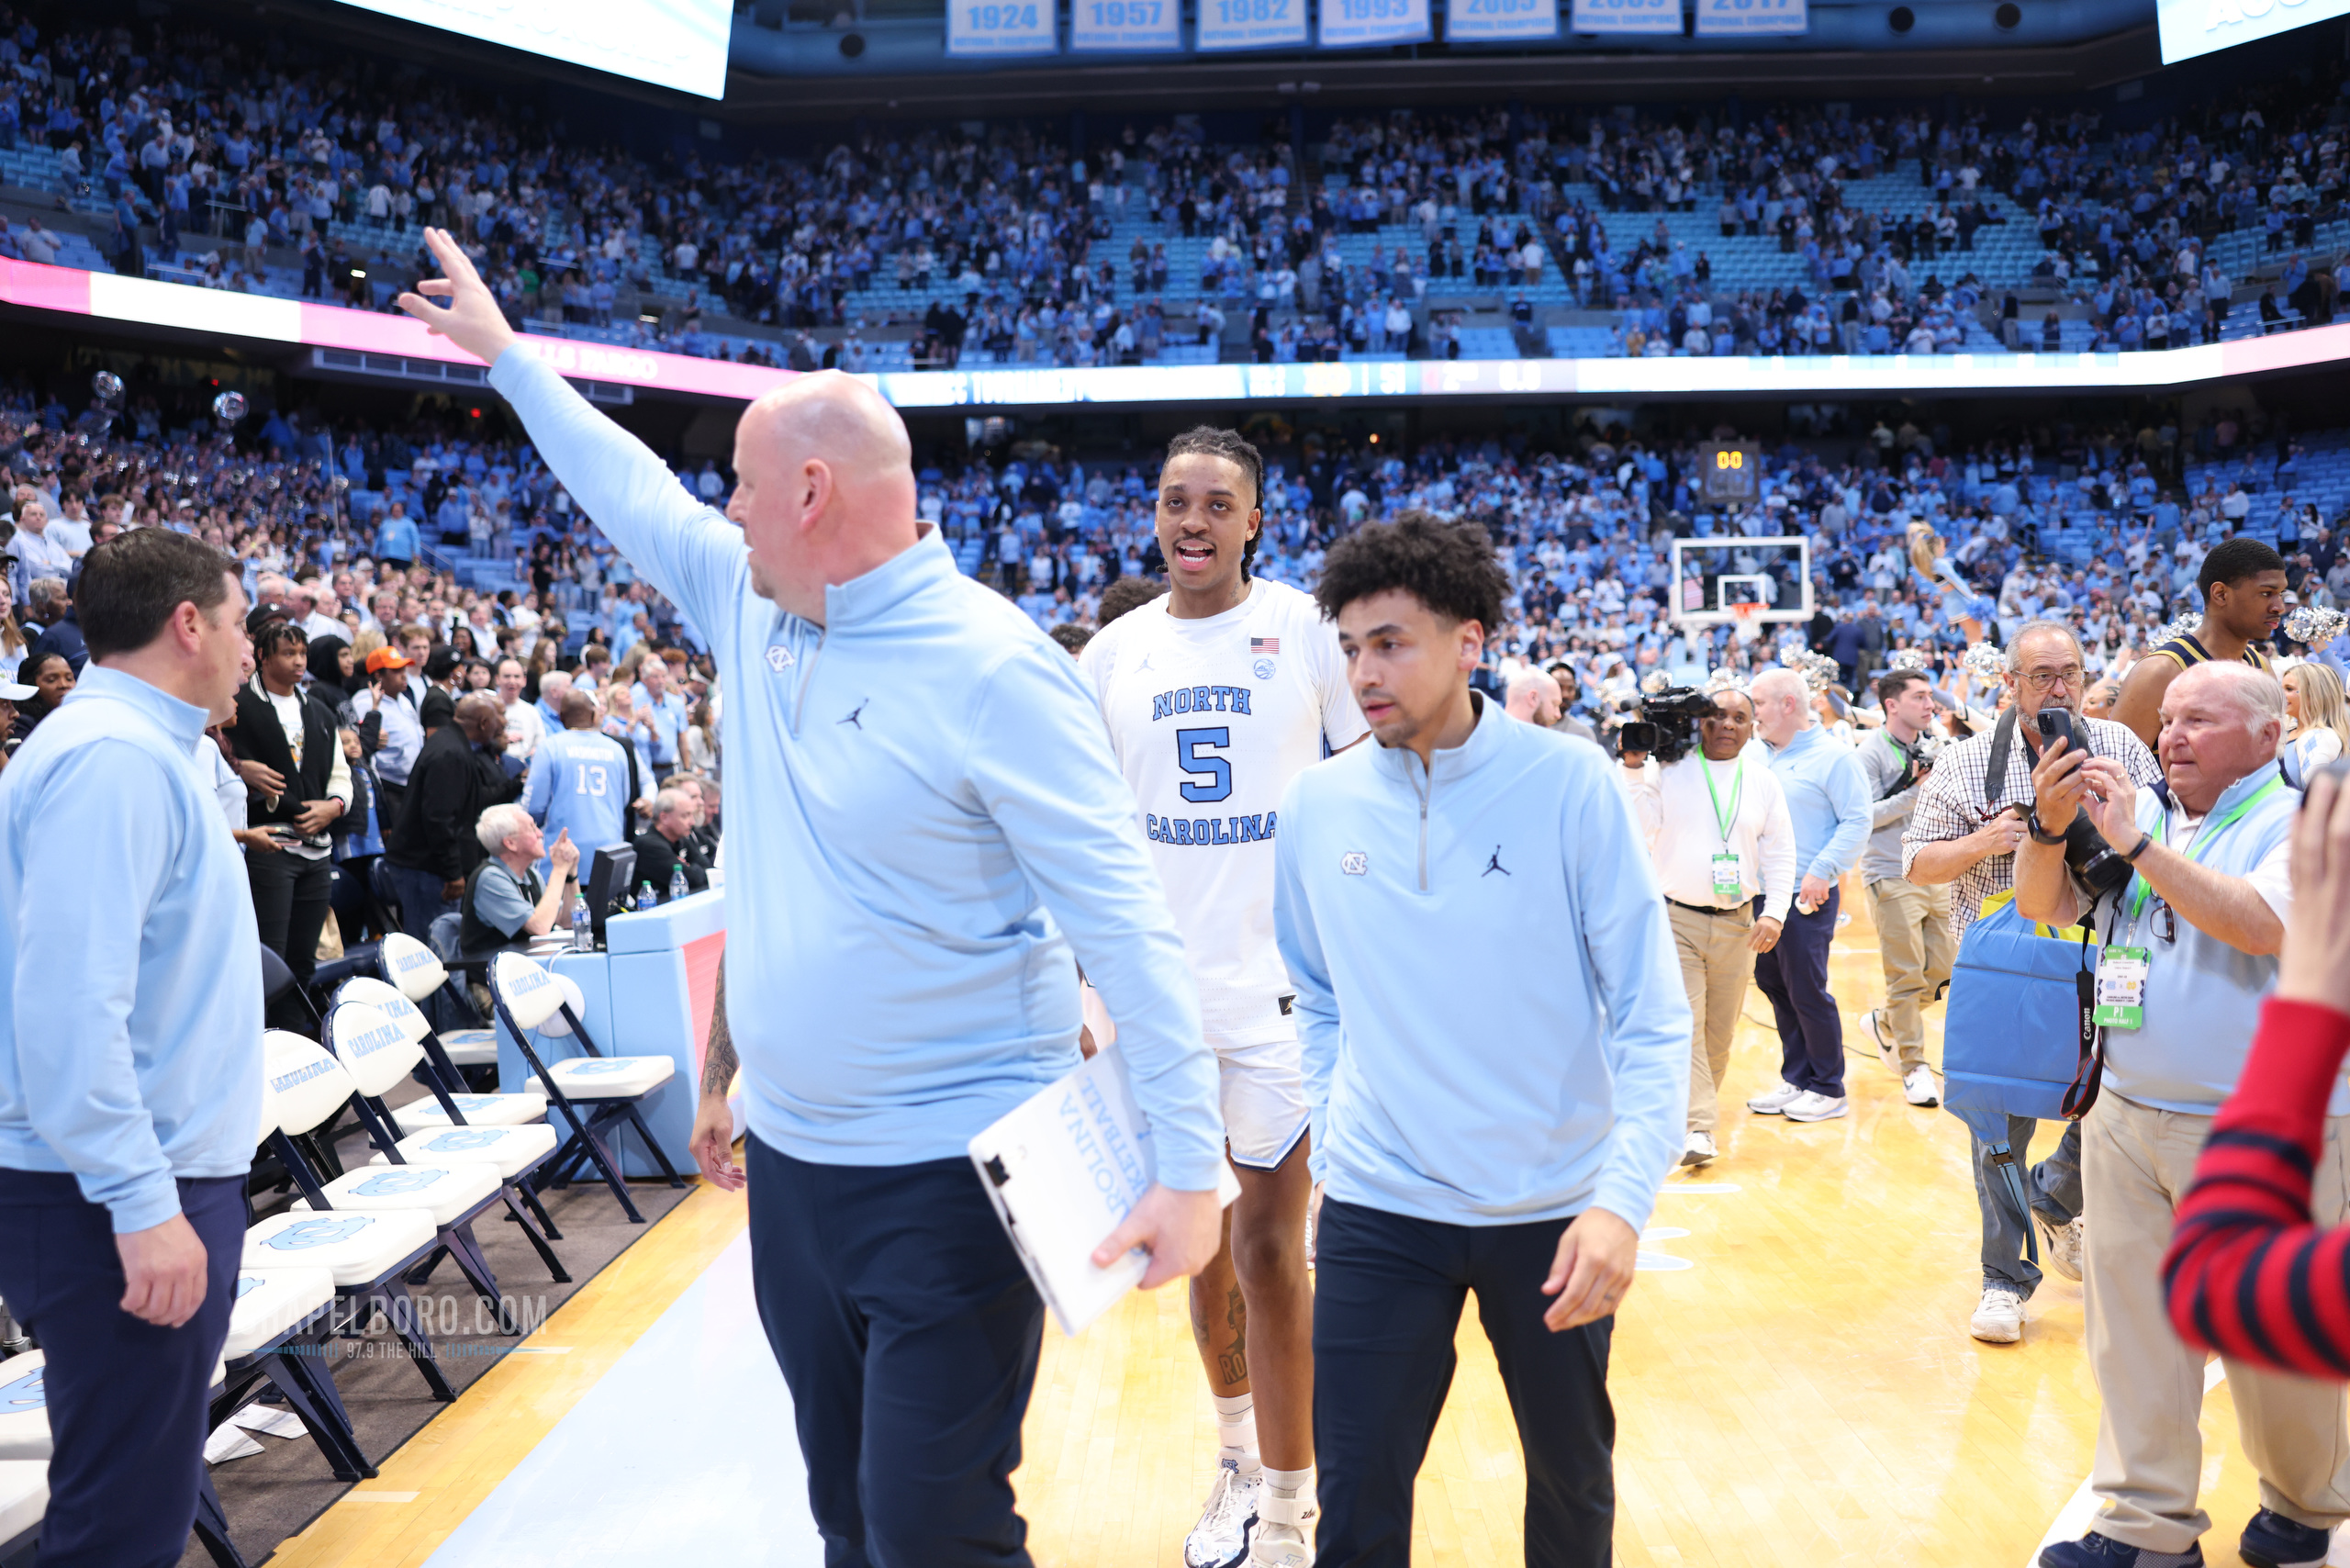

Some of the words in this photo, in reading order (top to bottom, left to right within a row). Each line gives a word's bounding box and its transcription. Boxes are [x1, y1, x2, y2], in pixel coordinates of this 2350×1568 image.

[968, 5, 1038, 30] 1924
[1091, 2, 1163, 26] 1957
[1217, 0, 1290, 23] 1982
[1340, 0, 1410, 20] 1993
[1717, 451, 1743, 470] 00
[1153, 686, 1252, 722] NORTH
[1176, 726, 1233, 803] 5
[576, 764, 607, 797] 13
[1147, 812, 1278, 846] CAROLINA
[396, 949, 437, 973] CAROLINA
[509, 969, 551, 997] CAROLINA
[2083, 1007, 2092, 1041] Canon
[2113, 1006, 2123, 1018] P1
[347, 1022, 406, 1058] CAROLINA
